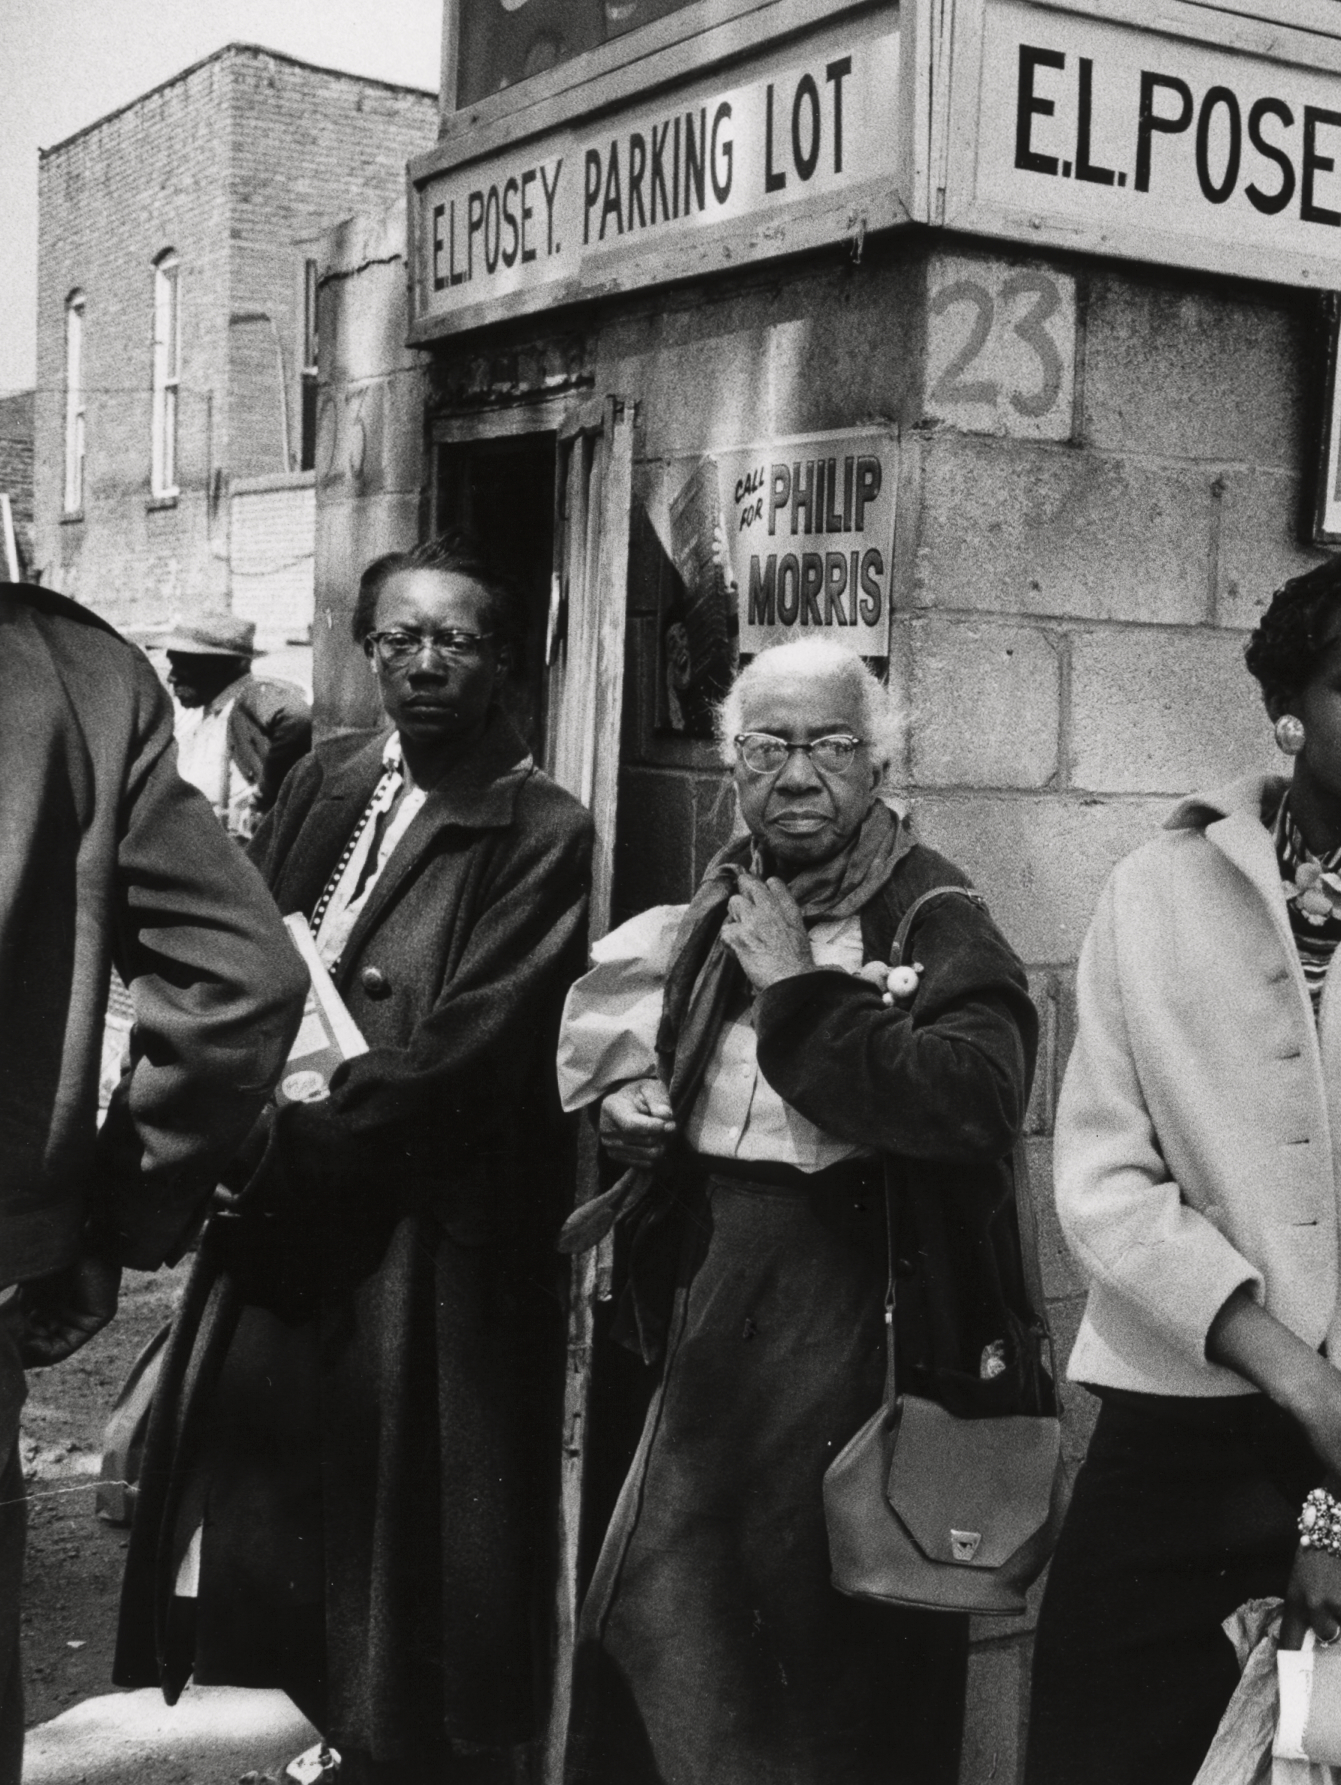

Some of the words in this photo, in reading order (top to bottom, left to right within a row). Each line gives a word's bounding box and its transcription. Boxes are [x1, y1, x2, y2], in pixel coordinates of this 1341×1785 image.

[582, 101, 734, 247] PARKING
[764, 54, 853, 194] LOT
[929, 271, 1065, 419] 23
[735, 465, 764, 504] CALL
[739, 497, 763, 531] FOR
[768, 455, 883, 535] PHILIP
[748, 548, 884, 627] MORRIS
